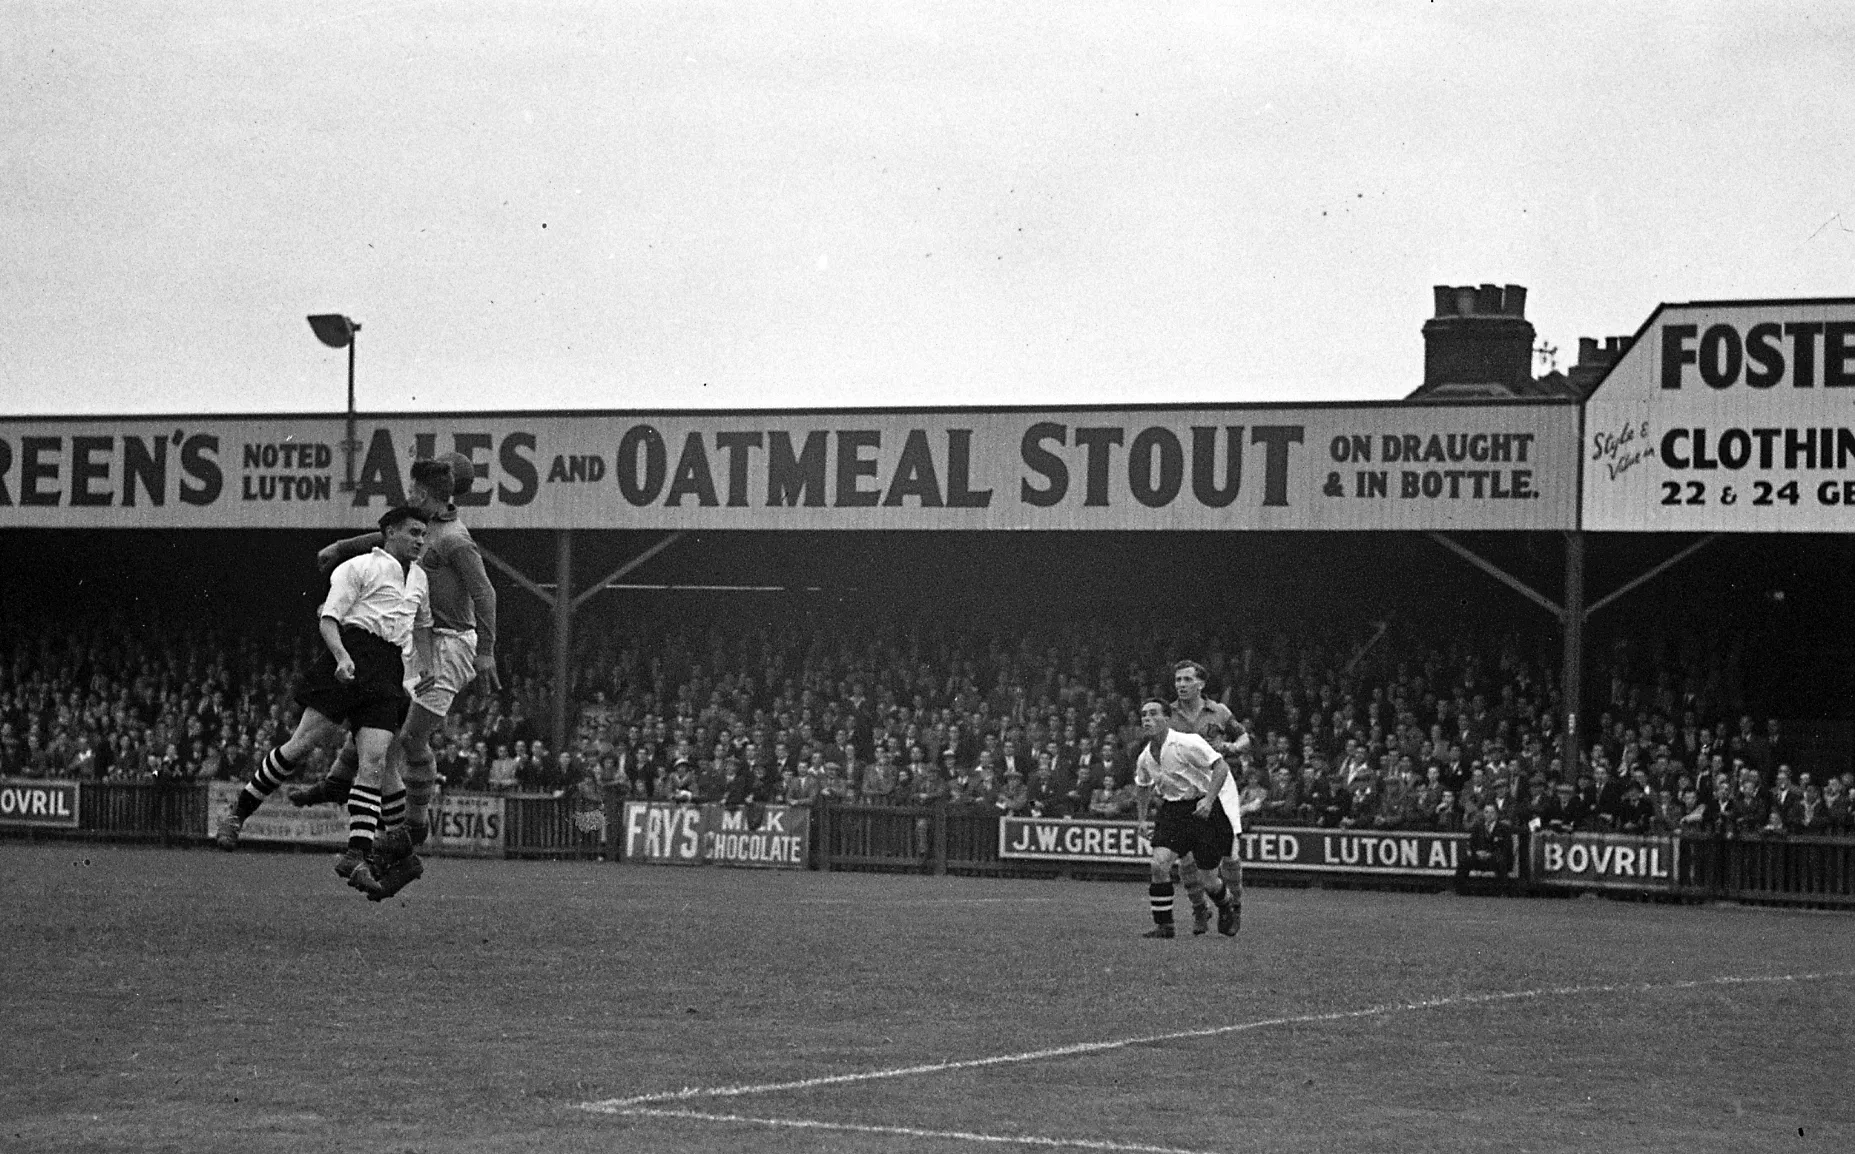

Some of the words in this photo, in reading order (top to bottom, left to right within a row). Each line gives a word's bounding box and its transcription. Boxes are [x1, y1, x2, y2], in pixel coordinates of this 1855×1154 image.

[243, 443, 332, 469] NOTED
[1329, 434, 1372, 462] ON
[1381, 433, 1534, 463] DRAUGHT
[1592, 422, 1634, 460] Style
[546, 455, 606, 483] AND
[616, 424, 994, 508] OATMEAL
[1019, 421, 1304, 508] STOUT
[242, 475, 331, 501] LUTON
[1323, 472, 1345, 497] &
[1355, 471, 1388, 498] IN
[1401, 470, 1540, 499] BOTTLE.
[1661, 480, 1706, 506] 22
[1720, 486, 1738, 506] &
[1752, 480, 1799, 506] 24
[428, 809, 499, 839] VESTAS
[704, 831, 801, 863] CHOCOLATE
[1323, 836, 1418, 867] LUTON
[1543, 842, 1669, 878] BOVRIL
